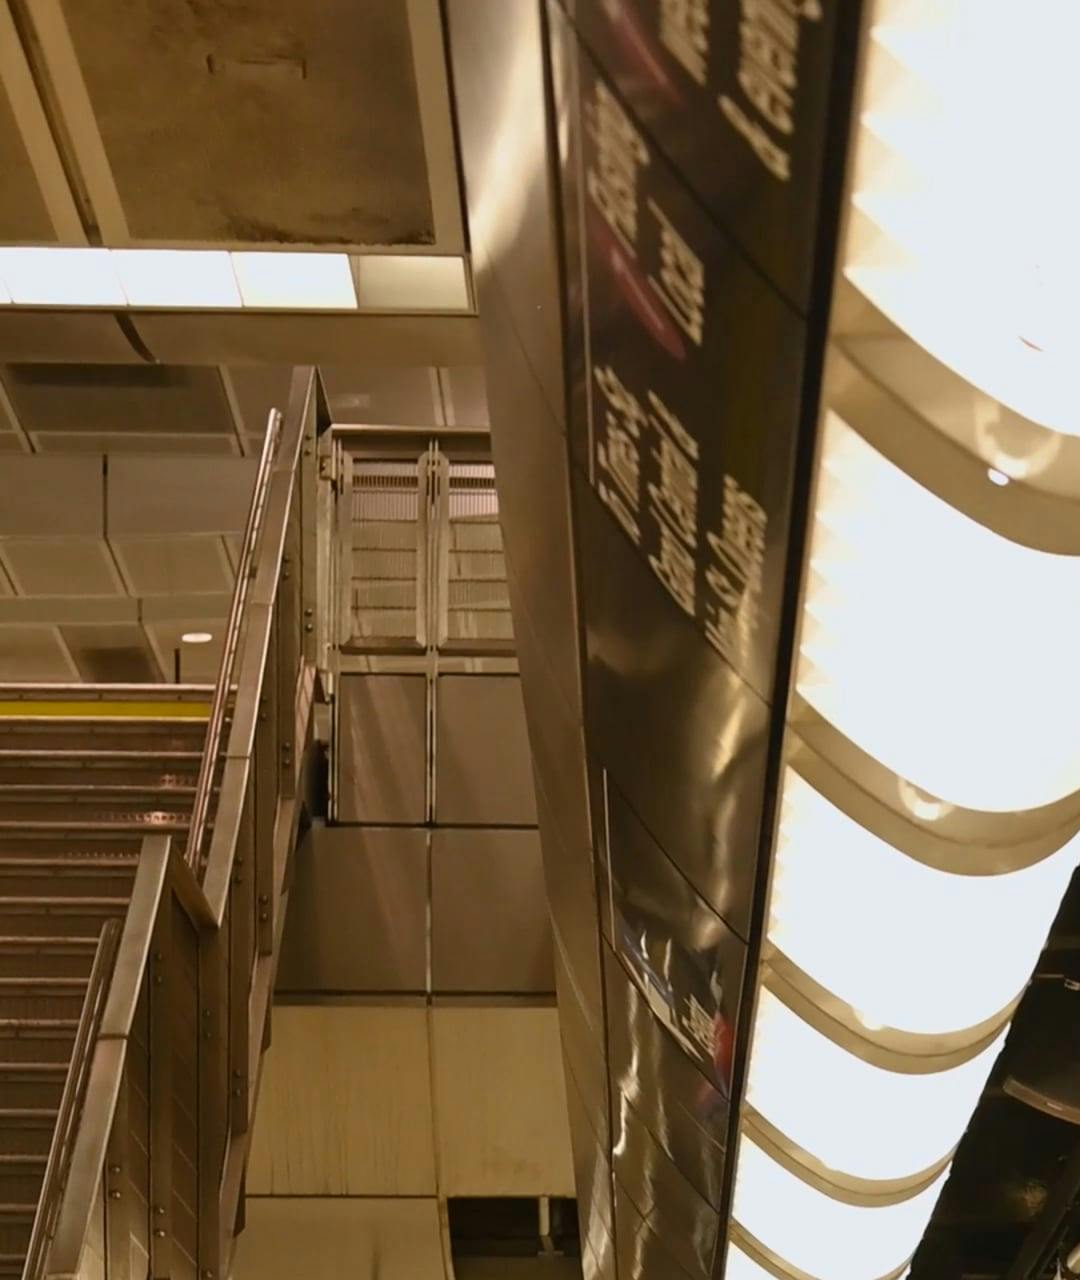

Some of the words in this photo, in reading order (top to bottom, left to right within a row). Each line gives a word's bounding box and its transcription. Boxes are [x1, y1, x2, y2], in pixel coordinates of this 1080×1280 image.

[647, 197, 705, 346] Local
[598, 410, 641, 513] Times
[598, 479, 641, 546] To
[648, 413, 698, 549] Central
[648, 504, 697, 617] Grand
